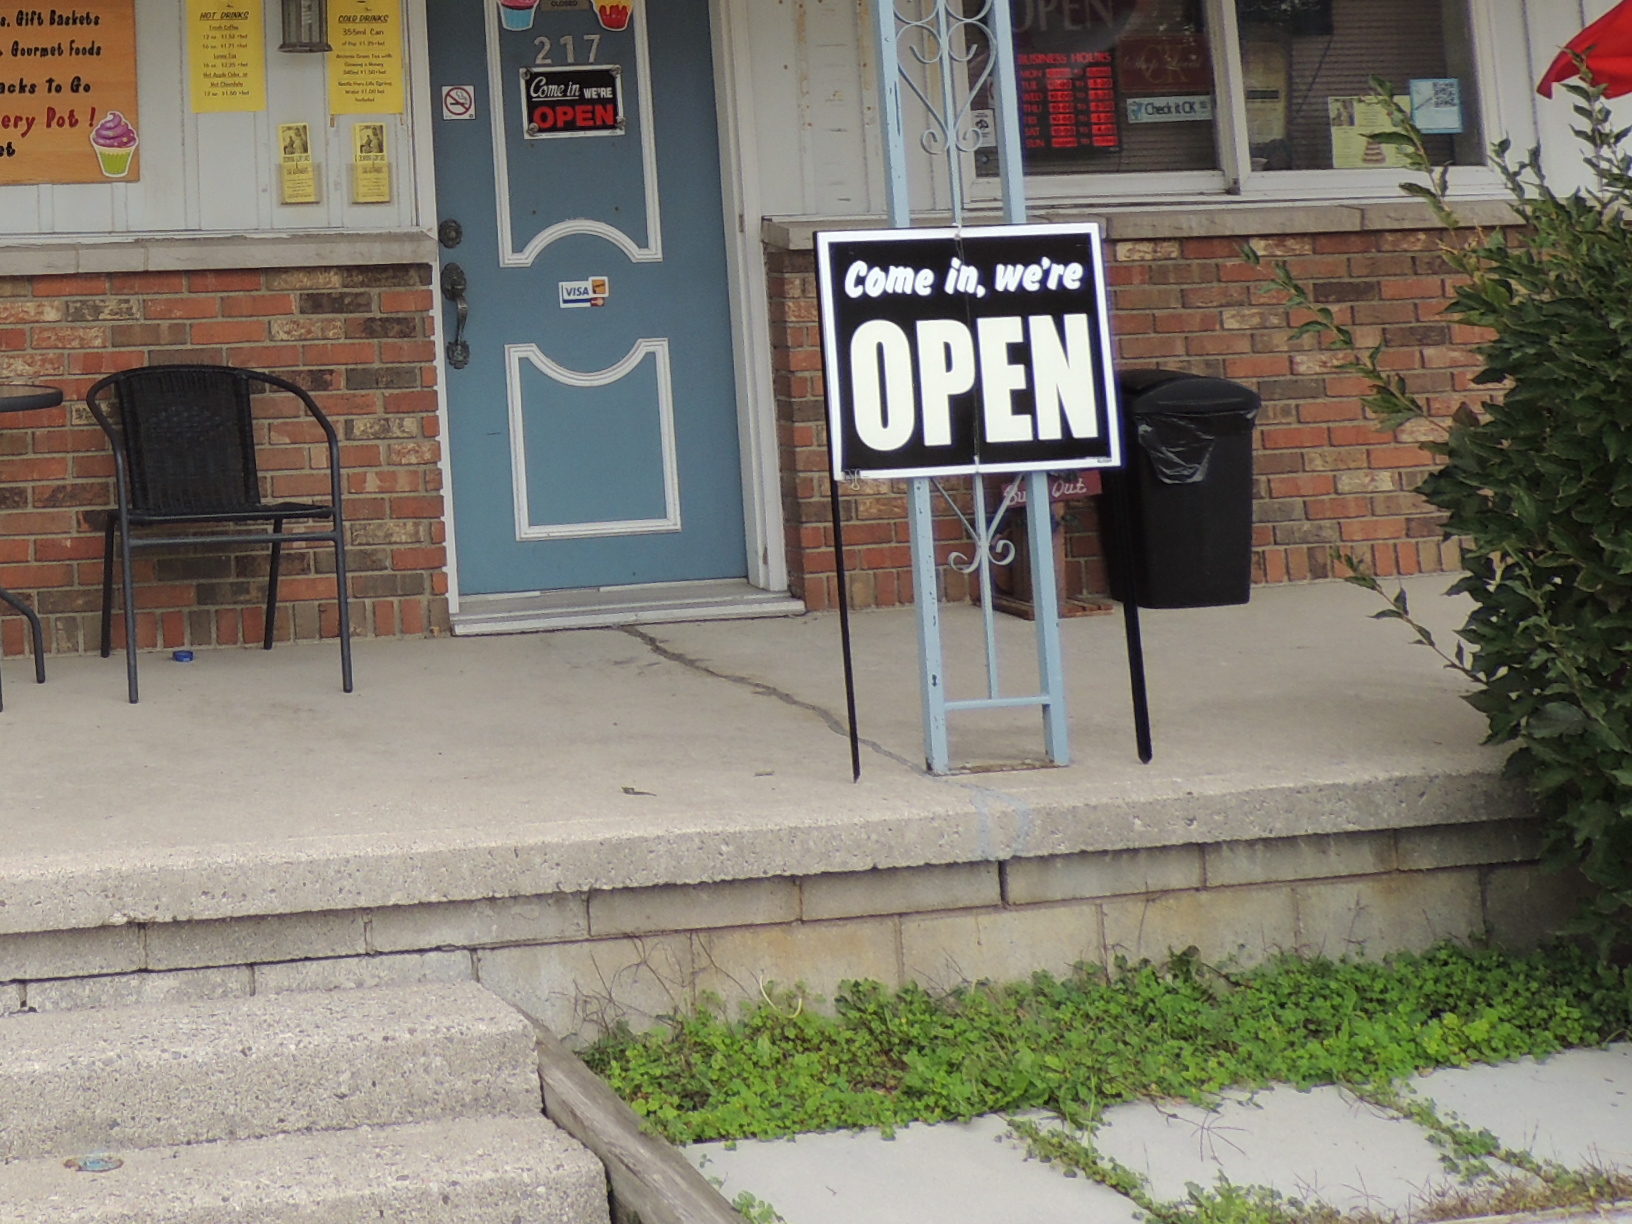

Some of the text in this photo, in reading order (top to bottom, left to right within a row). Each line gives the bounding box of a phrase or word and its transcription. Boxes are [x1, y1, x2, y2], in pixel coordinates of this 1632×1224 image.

[15, 10, 45, 27] Gift
[49, 9, 101, 27] Baskets
[220, 11, 249, 20] DRINKS
[338, 14, 389, 23] COLD DRINKS
[10, 40, 65, 58] Gourmet
[68, 39, 103, 58] Foods
[533, 34, 601, 65] 217
[1071, 52, 1112, 63] HOURS
[45, 77, 64, 95] To
[70, 76, 92, 94] Go
[529, 76, 613, 99] Come in WE'RE
[533, 104, 615, 128] OPEN
[1145, 102, 1173, 115] Check
[1182, 101, 1196, 114] CK
[844, 256, 1084, 298] Come in, we're
[564, 286, 590, 297] VISA
[850, 313, 1100, 452] OPEN
[1051, 477, 1087, 498] Out
